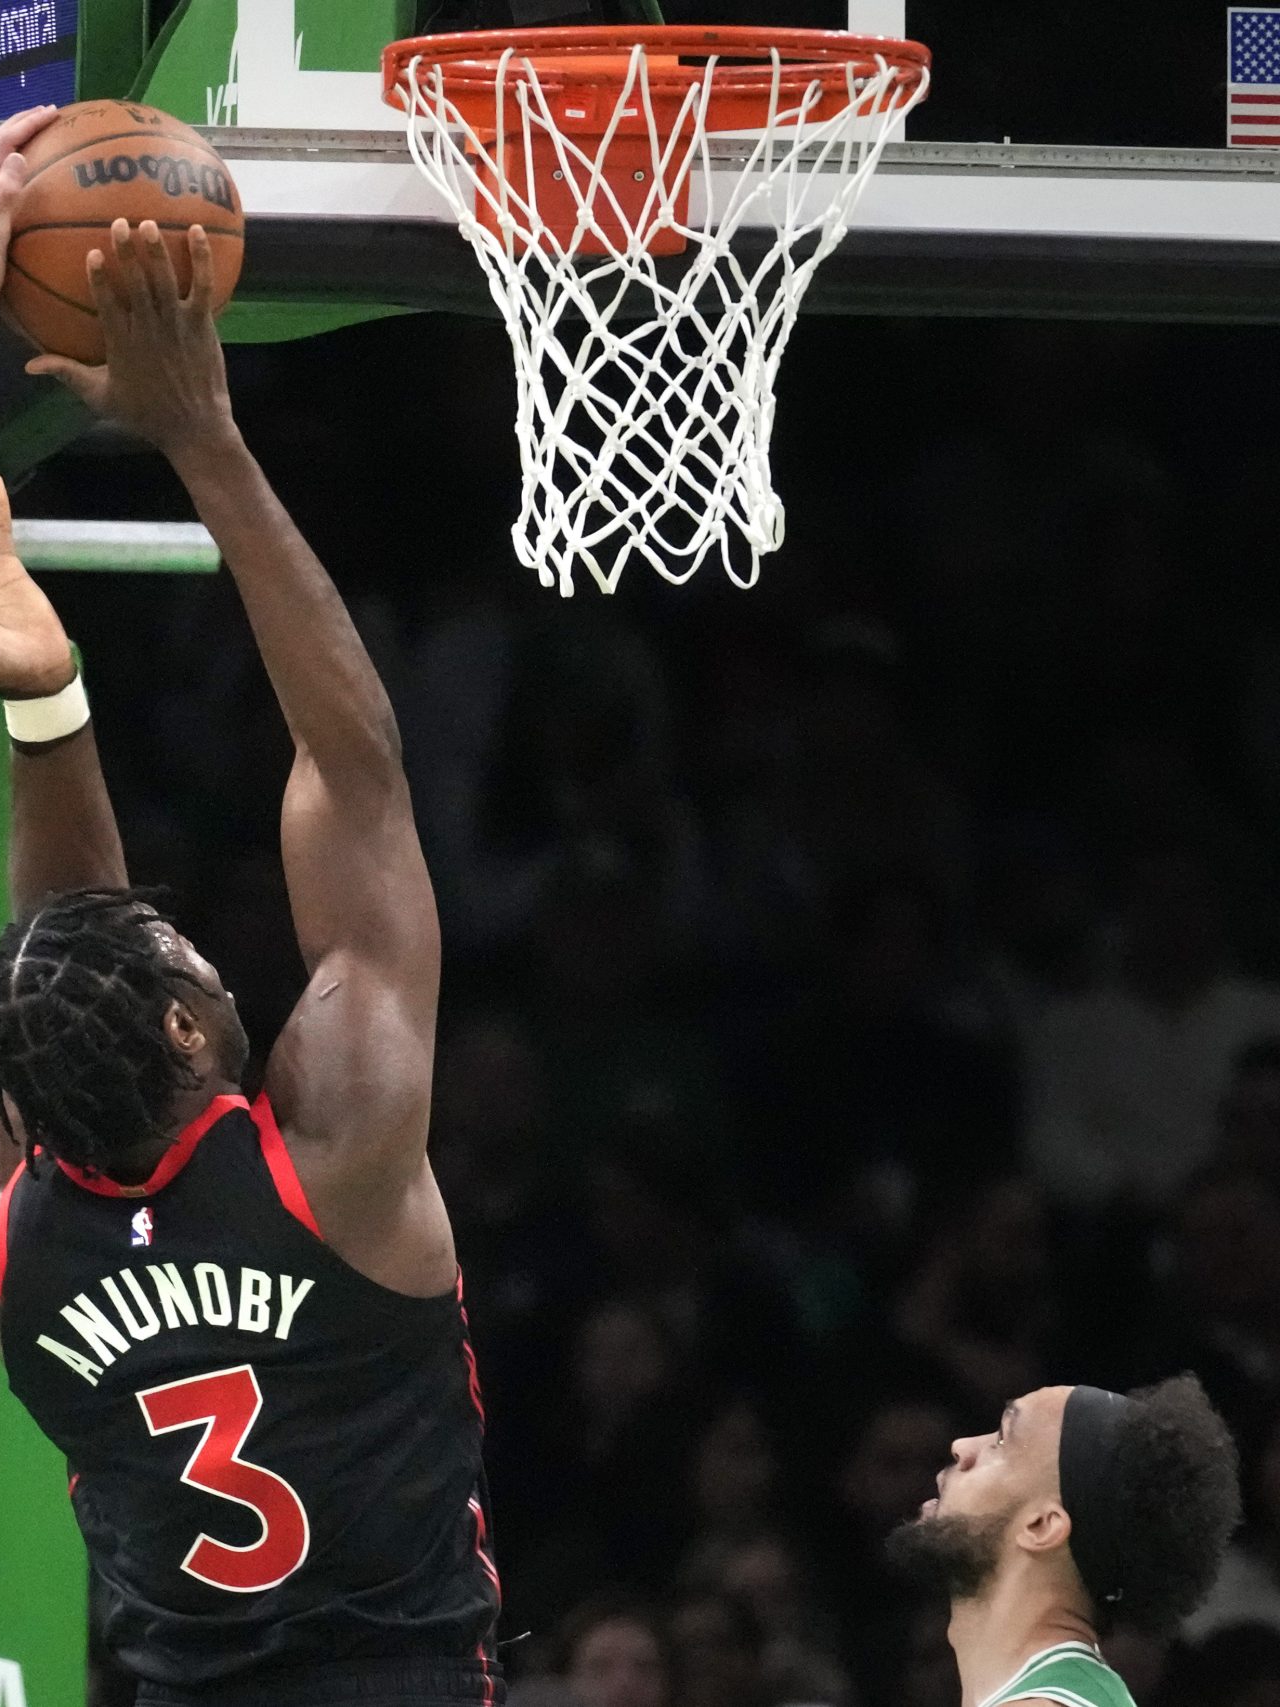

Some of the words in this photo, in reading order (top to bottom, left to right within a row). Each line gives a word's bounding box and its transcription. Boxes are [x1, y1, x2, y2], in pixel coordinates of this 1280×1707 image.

[73, 154, 236, 214] Wilson
[36, 1262, 316, 1387] ANUNOBY
[135, 1364, 311, 1593] 3
